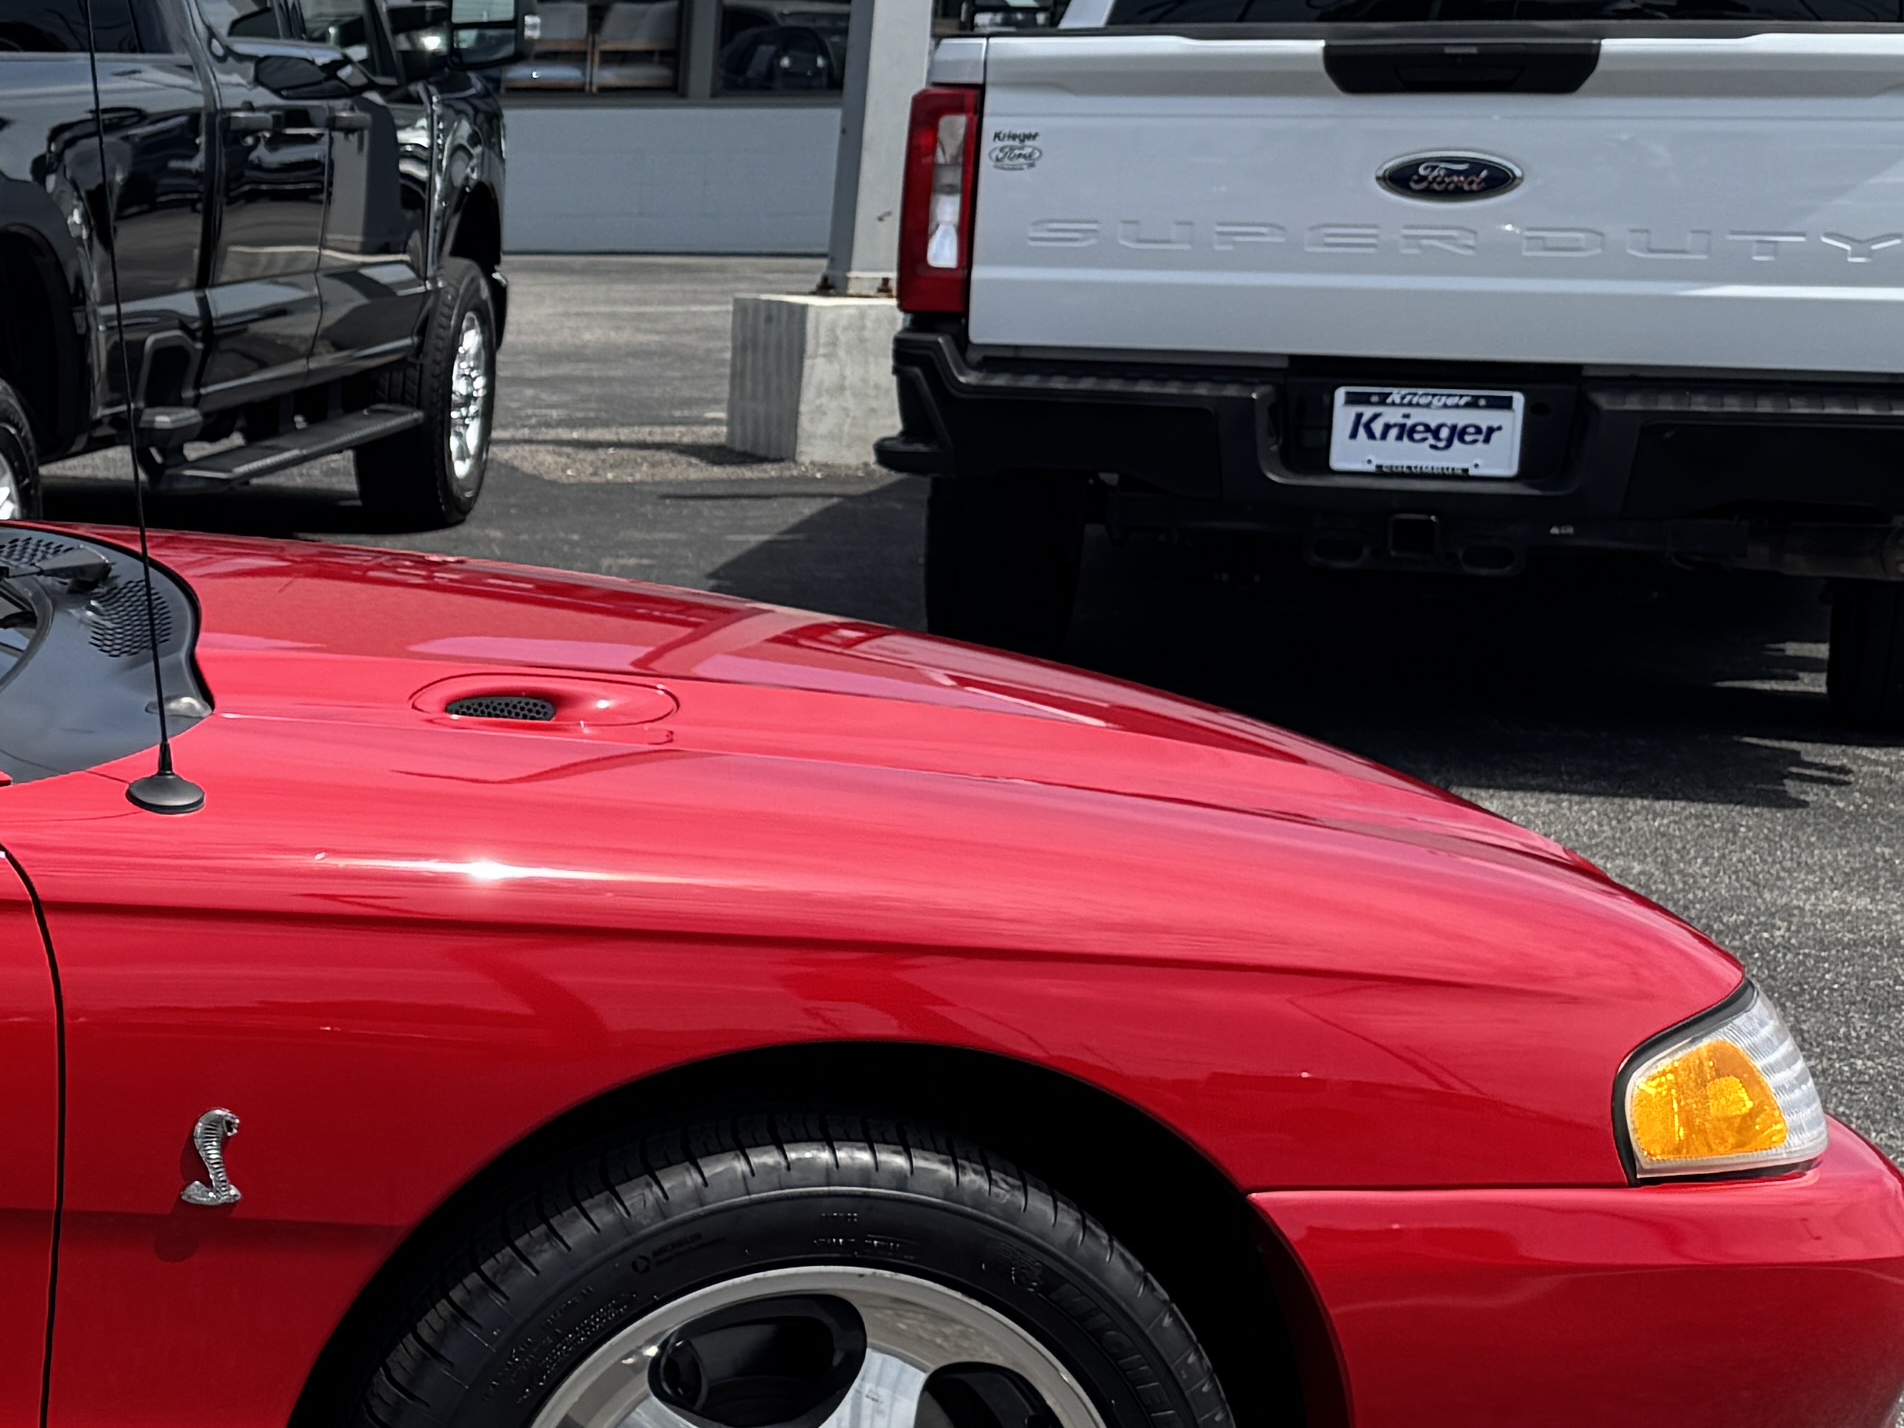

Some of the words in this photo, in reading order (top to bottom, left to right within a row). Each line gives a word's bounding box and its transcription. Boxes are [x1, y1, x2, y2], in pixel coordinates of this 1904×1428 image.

[1409, 162, 1488, 191] Ford
[1026, 219, 1479, 256] SUPER
[1522, 222, 1903, 263] DUTY
[1386, 391, 1472, 409] Krieger
[1348, 412, 1503, 451] Krieger
